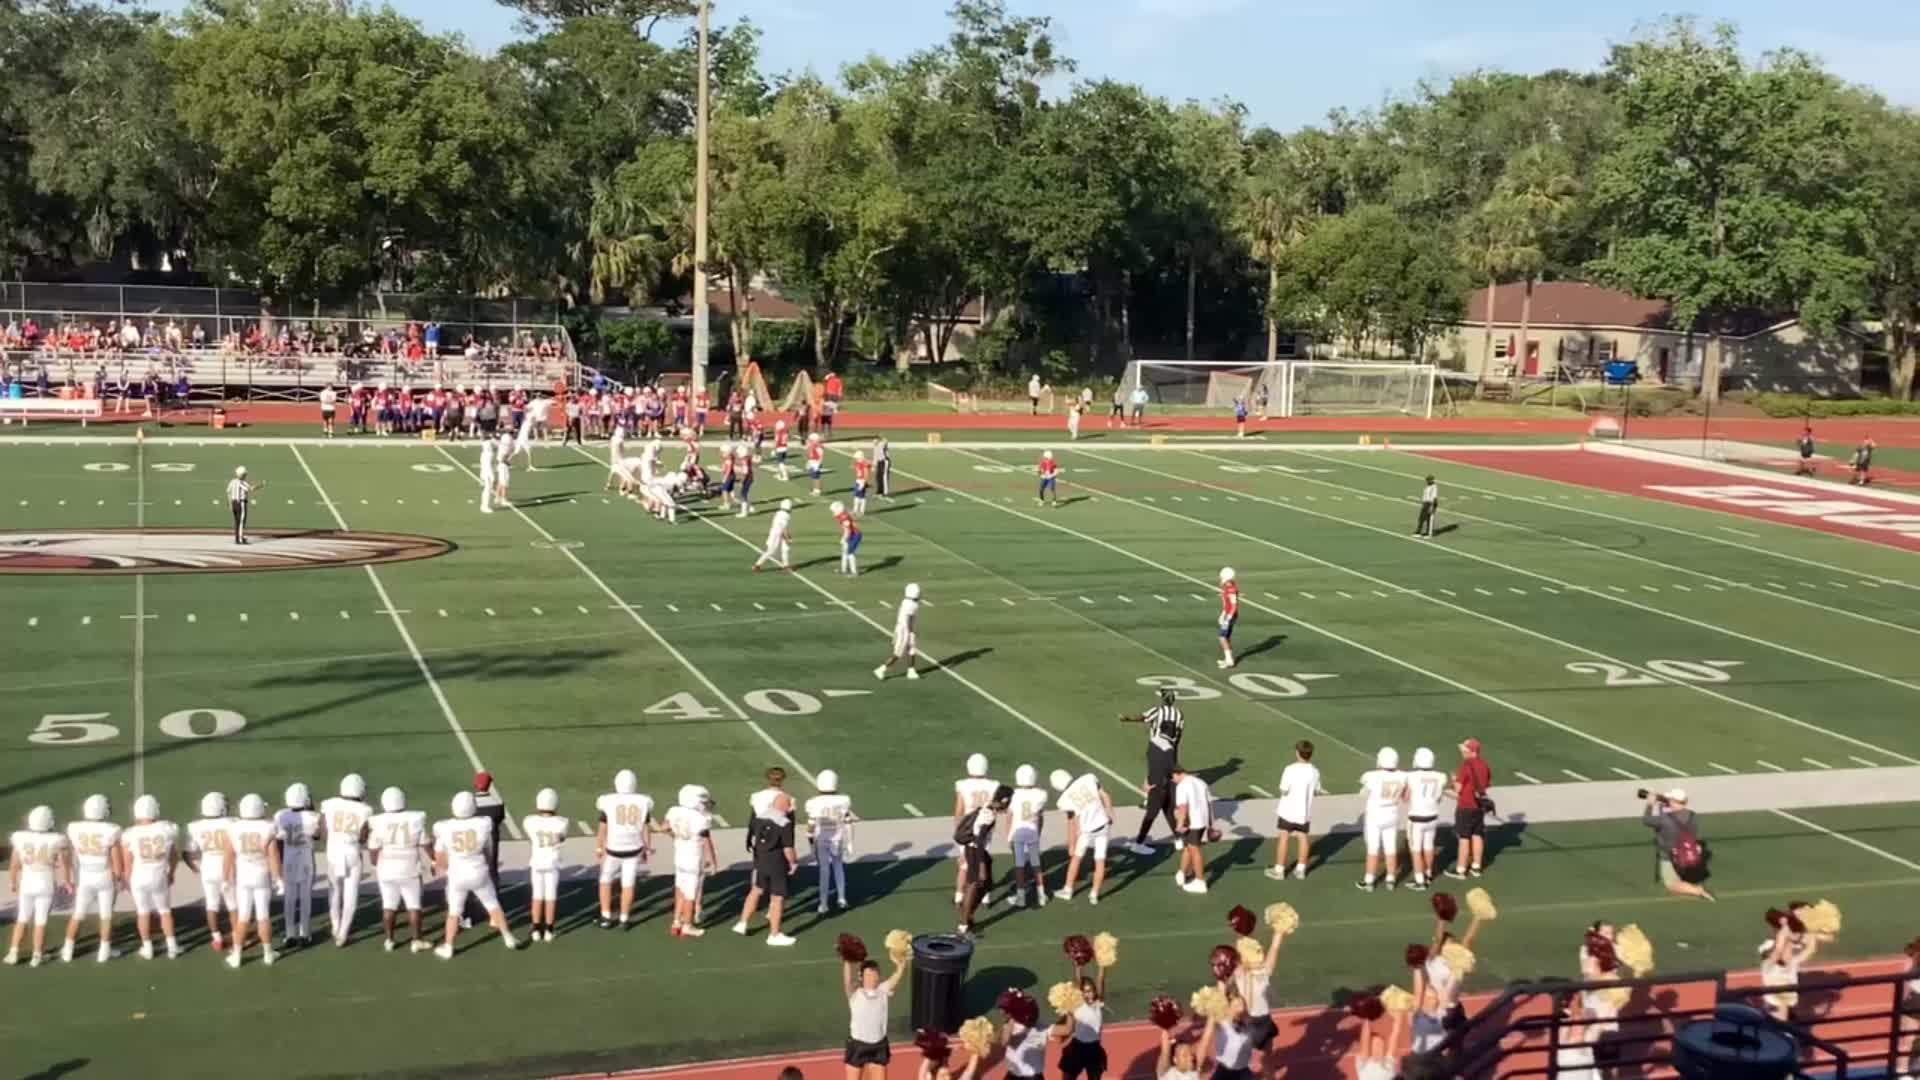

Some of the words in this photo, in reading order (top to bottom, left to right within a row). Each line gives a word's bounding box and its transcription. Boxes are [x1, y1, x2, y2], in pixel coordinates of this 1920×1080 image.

[1136, 673, 1308, 699] 30
[1565, 659, 1731, 686] 20
[643, 689, 822, 719] 40
[26, 708, 247, 744] 50
[387, 821, 411, 845] 71
